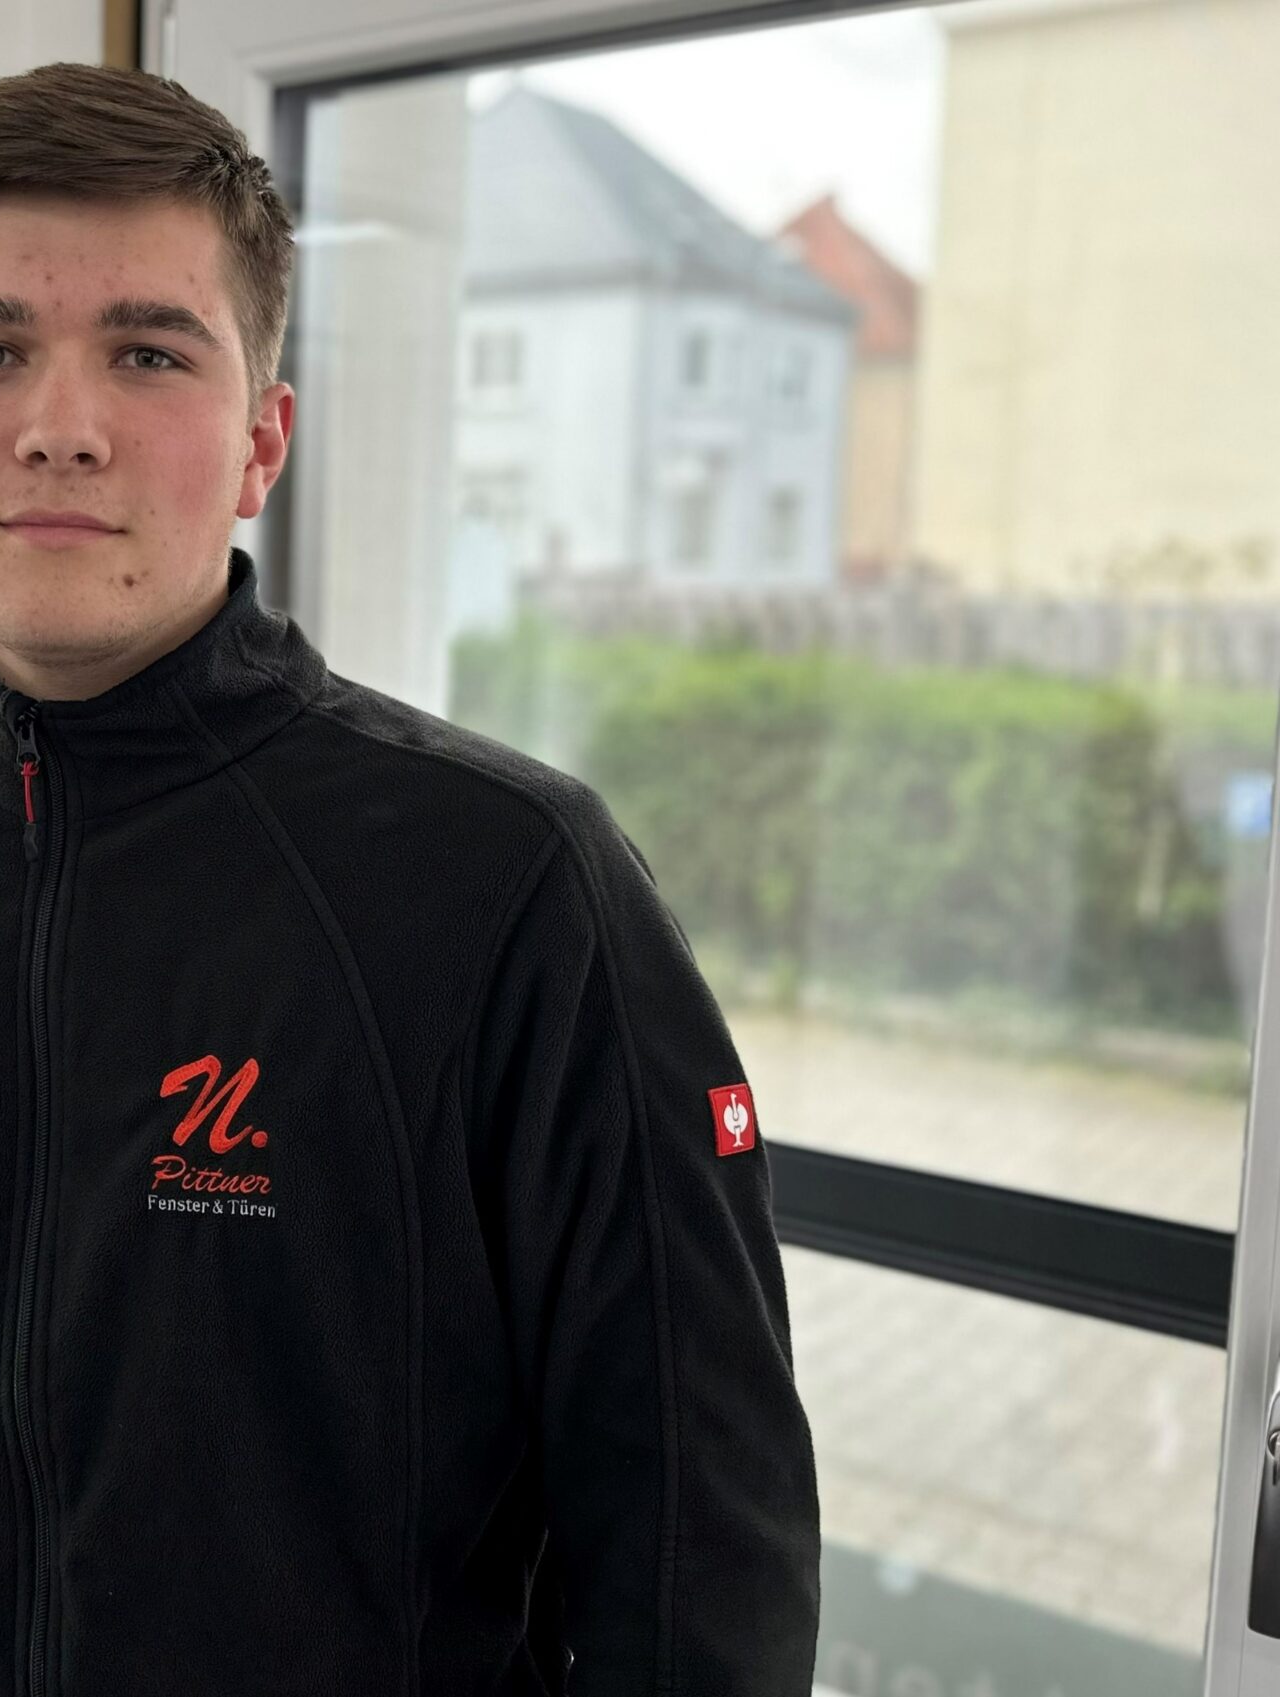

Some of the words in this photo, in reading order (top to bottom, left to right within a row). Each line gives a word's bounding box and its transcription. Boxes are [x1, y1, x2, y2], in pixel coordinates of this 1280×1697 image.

[151, 1155, 272, 1194] Pittner
[148, 1194, 210, 1213] Fenster
[212, 1199, 224, 1214] &
[227, 1199, 276, 1218] Türen
